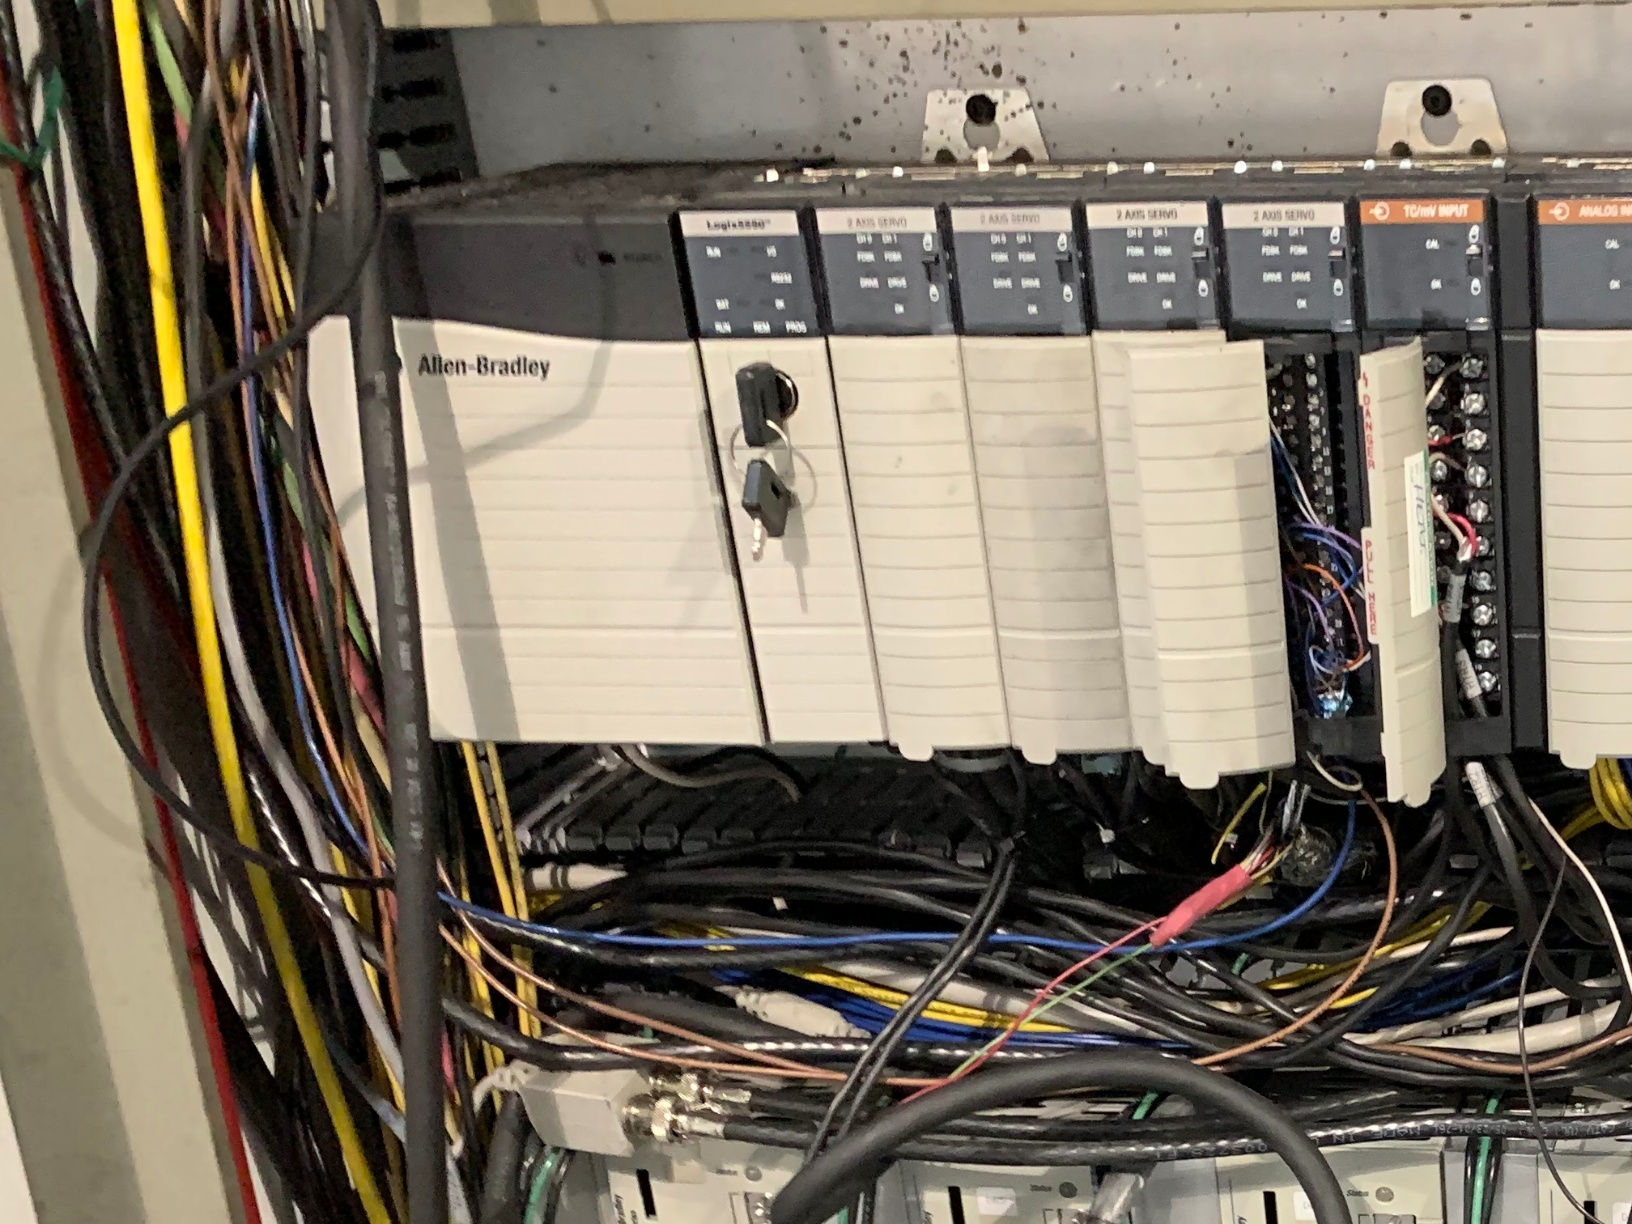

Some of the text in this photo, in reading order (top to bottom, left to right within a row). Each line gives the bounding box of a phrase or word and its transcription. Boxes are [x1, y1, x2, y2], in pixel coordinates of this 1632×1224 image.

[1116, 209, 1177, 220] 2 AXIS SERVO
[1253, 209, 1315, 221] 2 AXIS SERVO
[1403, 203, 1470, 218] TC/mV INPUT
[1578, 204, 1618, 218] ANALOG
[855, 218, 876, 228] AXIS
[878, 218, 907, 228] SERVO
[988, 214, 1008, 225] AXIS
[1011, 214, 1040, 225] SERVO
[418, 353, 550, 382] Allen-Bradley
[1363, 396, 1375, 470] DANGER
[1365, 540, 1378, 636] PULL HERE
[1346, 1189, 1369, 1198] Status
